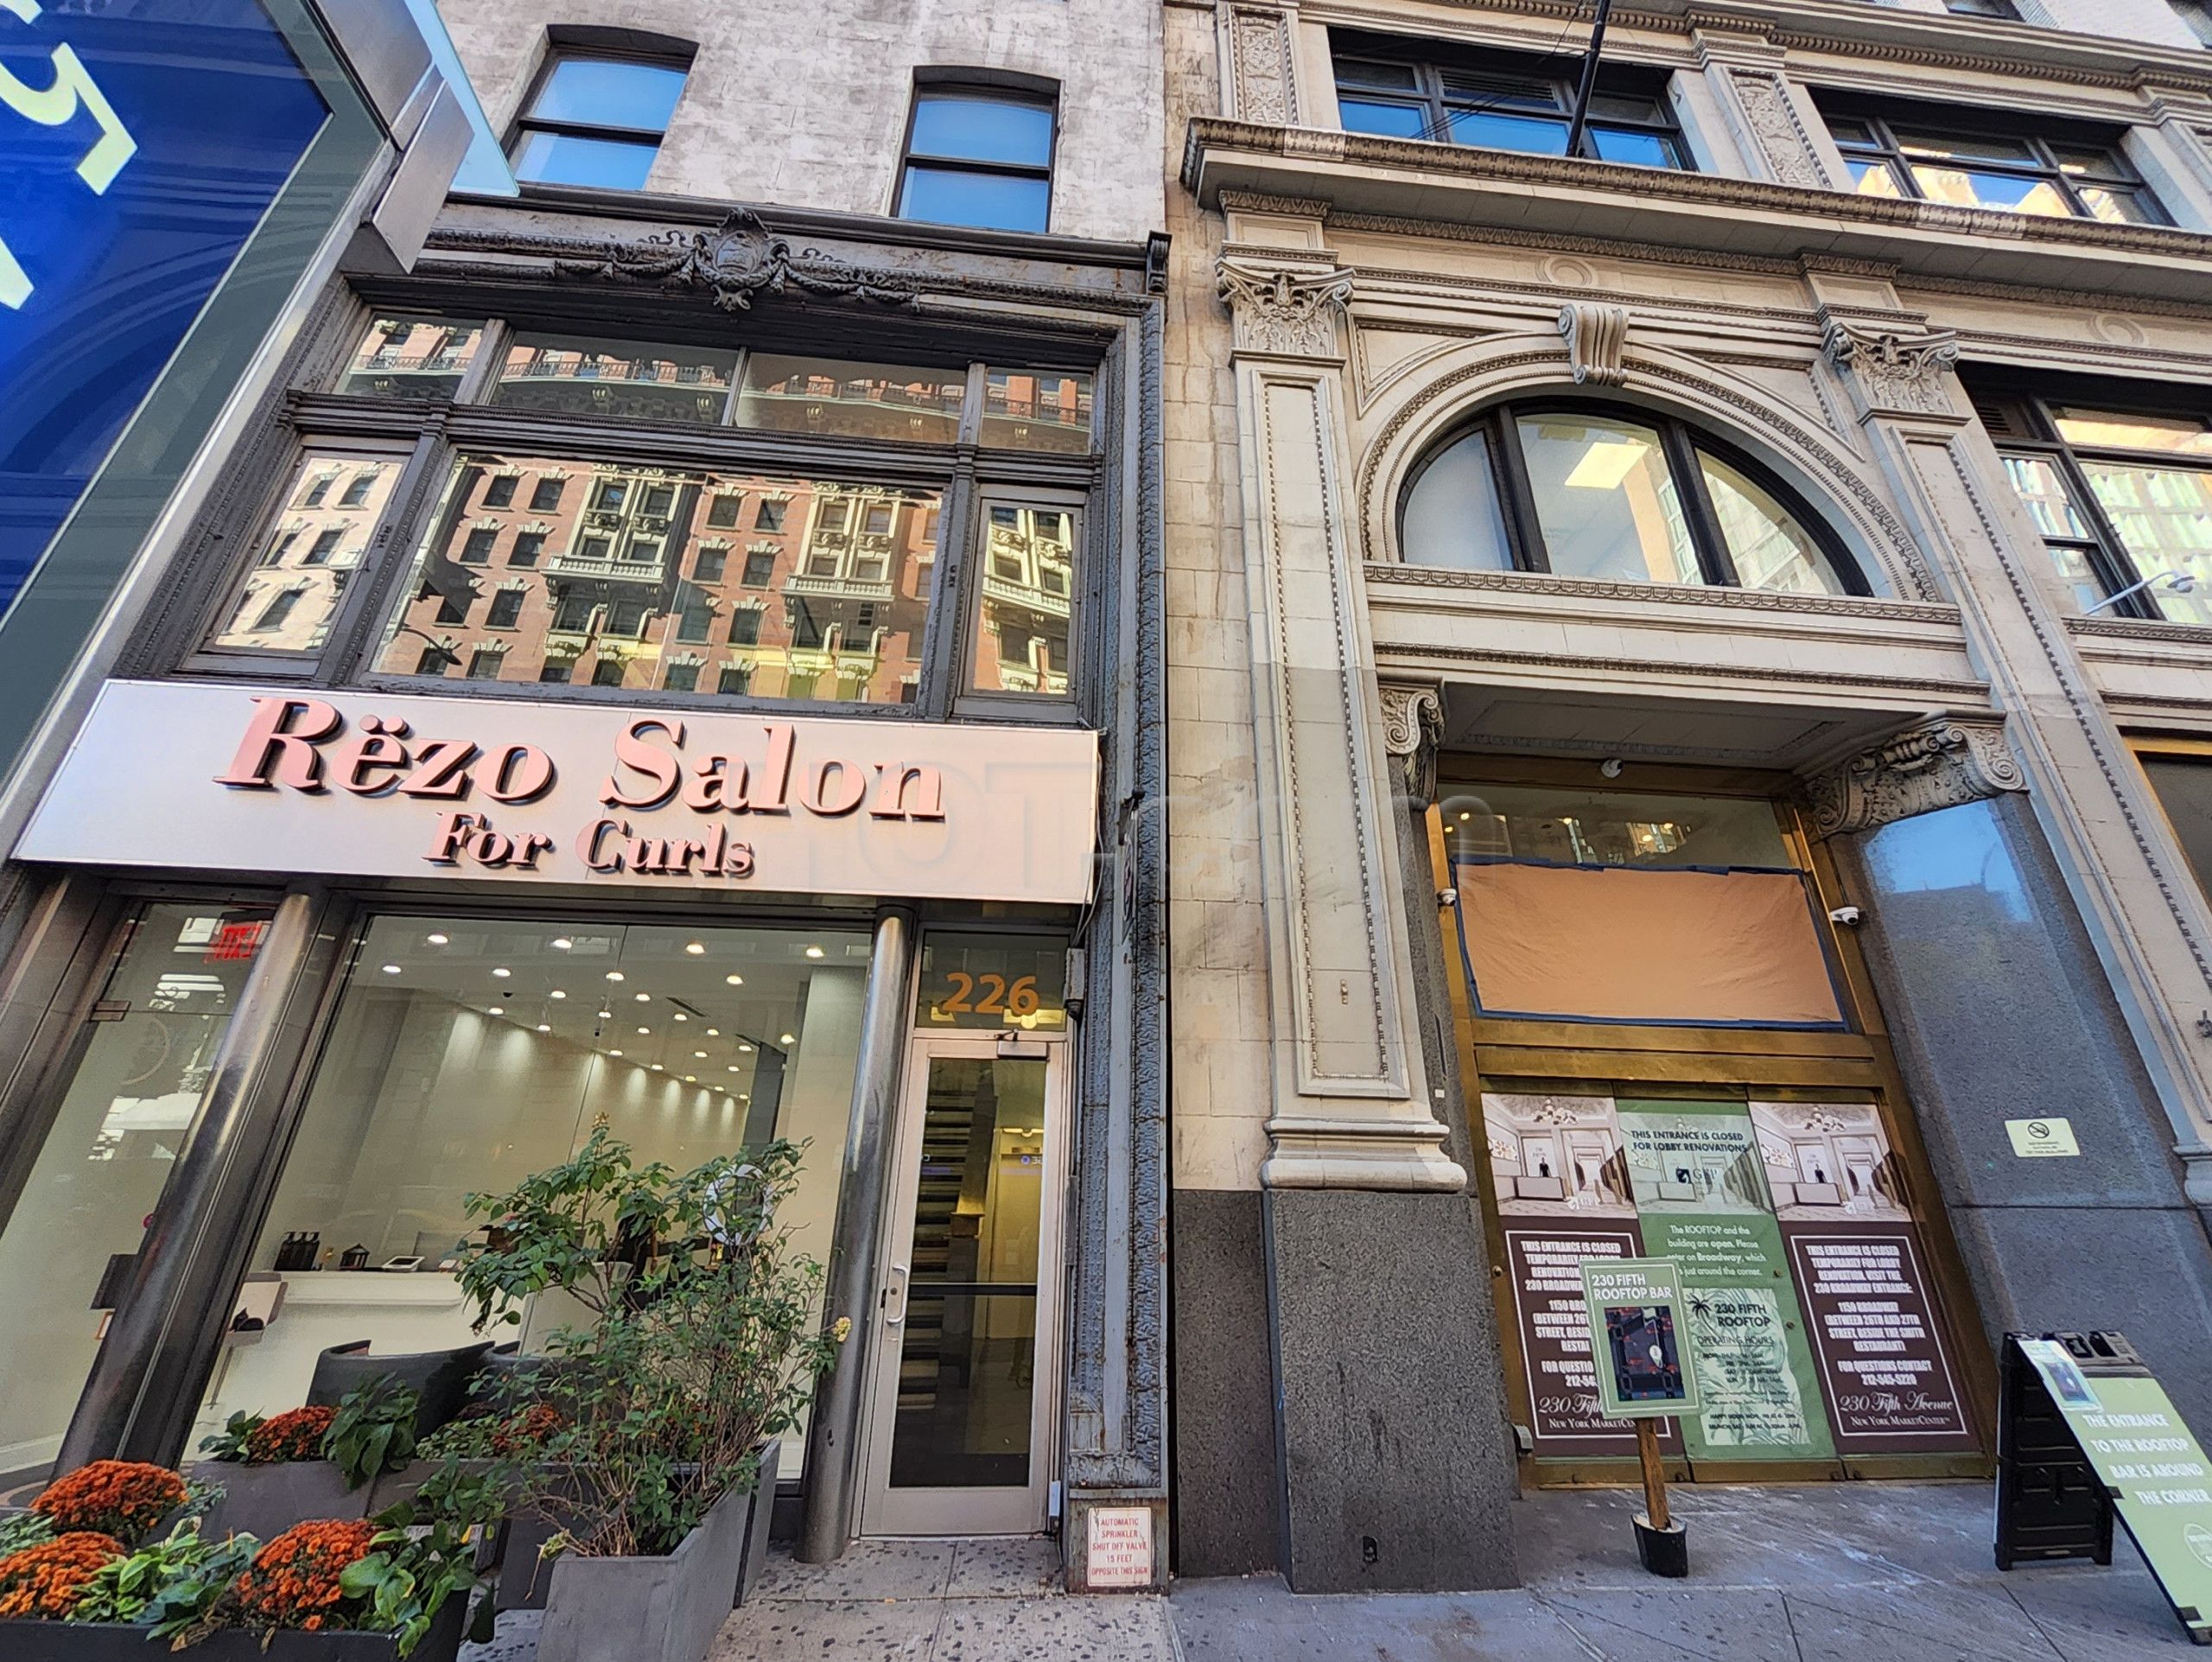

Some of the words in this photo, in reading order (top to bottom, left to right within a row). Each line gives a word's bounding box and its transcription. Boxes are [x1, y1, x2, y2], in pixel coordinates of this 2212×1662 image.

[212, 697, 555, 802] Rëzo
[599, 719, 945, 819] Salon
[422, 812, 554, 867] For
[575, 818, 754, 877] Curls
[942, 972, 1039, 1015] 226
[1631, 1130, 1651, 1139] THIS
[1653, 1130, 1700, 1140] ENTRANCE
[1701, 1131, 1709, 1140] IS
[1711, 1132, 1744, 1141] CLOSED
[1633, 1142, 1652, 1150] FOR
[1654, 1142, 1681, 1151] LOBBY
[1684, 1143, 1747, 1153] RENOVATIONS
[1669, 1225, 1684, 1234] The
[1684, 1225, 1721, 1234] ROOFTOP
[1723, 1226, 1738, 1235] and
[1738, 1226, 1751, 1235] the
[1521, 1241, 1541, 1252] THIS
[1541, 1241, 1581, 1252] ENTRANCE
[1581, 1242, 1591, 1253] IS
[1591, 1242, 1622, 1253] CLOSED
[1667, 1238, 1697, 1250] building
[1696, 1252, 1745, 1264] Broadway,
[1745, 1252, 1767, 1262] which
[1683, 1266, 1696, 1277] just
[1697, 1266, 1722, 1276] around
[1723, 1266, 1736, 1276] the
[1525, 1279, 1542, 1291] 230
[1592, 1274, 1615, 1287] 230
[1616, 1273, 1646, 1286] FIFTH
[1593, 1287, 1647, 1301] ROOFTOP
[1649, 1286, 1673, 1299] BAR
[1548, 1300, 1569, 1311] 1150
[1714, 1303, 1736, 1315] 230
[1738, 1303, 1767, 1315] FIFTH
[1574, 1313, 1590, 1325] 26T
[1718, 1316, 1770, 1328] ROOFTOP
[1567, 1327, 1592, 1339] BESID
[1541, 1360, 1559, 1372] FOR
[1559, 1360, 1594, 1373] QUESTIO
[1539, 1397, 1572, 1414] 230
[1840, 1395, 1870, 1412] 230
[1871, 1391, 1901, 1417] Fifth
[1904, 1391, 1954, 1411] Avenue
[2082, 1414, 2108, 1427] THE
[2107, 1413, 2170, 1427] ENTRANCE
[2090, 1439, 2112, 1453] TO
[2110, 1438, 2136, 1453] THE
[2133, 1437, 2190, 1452] ROOFTOP
[2108, 1464, 2138, 1479] BAR
[2136, 1464, 2152, 1478] IS
[2151, 1462, 2203, 1477] AROUND
[2133, 1490, 2162, 1505] THE
[2160, 1488, 2212, 1504] CORNER
[1101, 1518, 1139, 1526] AUTOMATIC
[1102, 1530, 1138, 1538] SPRINKLER
[1092, 1542, 1109, 1551] SHUT
[1111, 1542, 1123, 1551] OFF
[1126, 1542, 1147, 1551] VALVE
[1116, 1554, 1132, 1563] FEET
[1091, 1567, 1118, 1576] OPPOSITE
[1120, 1567, 1133, 1576] THIS
[1135, 1566, 1147, 1575] SIGN
